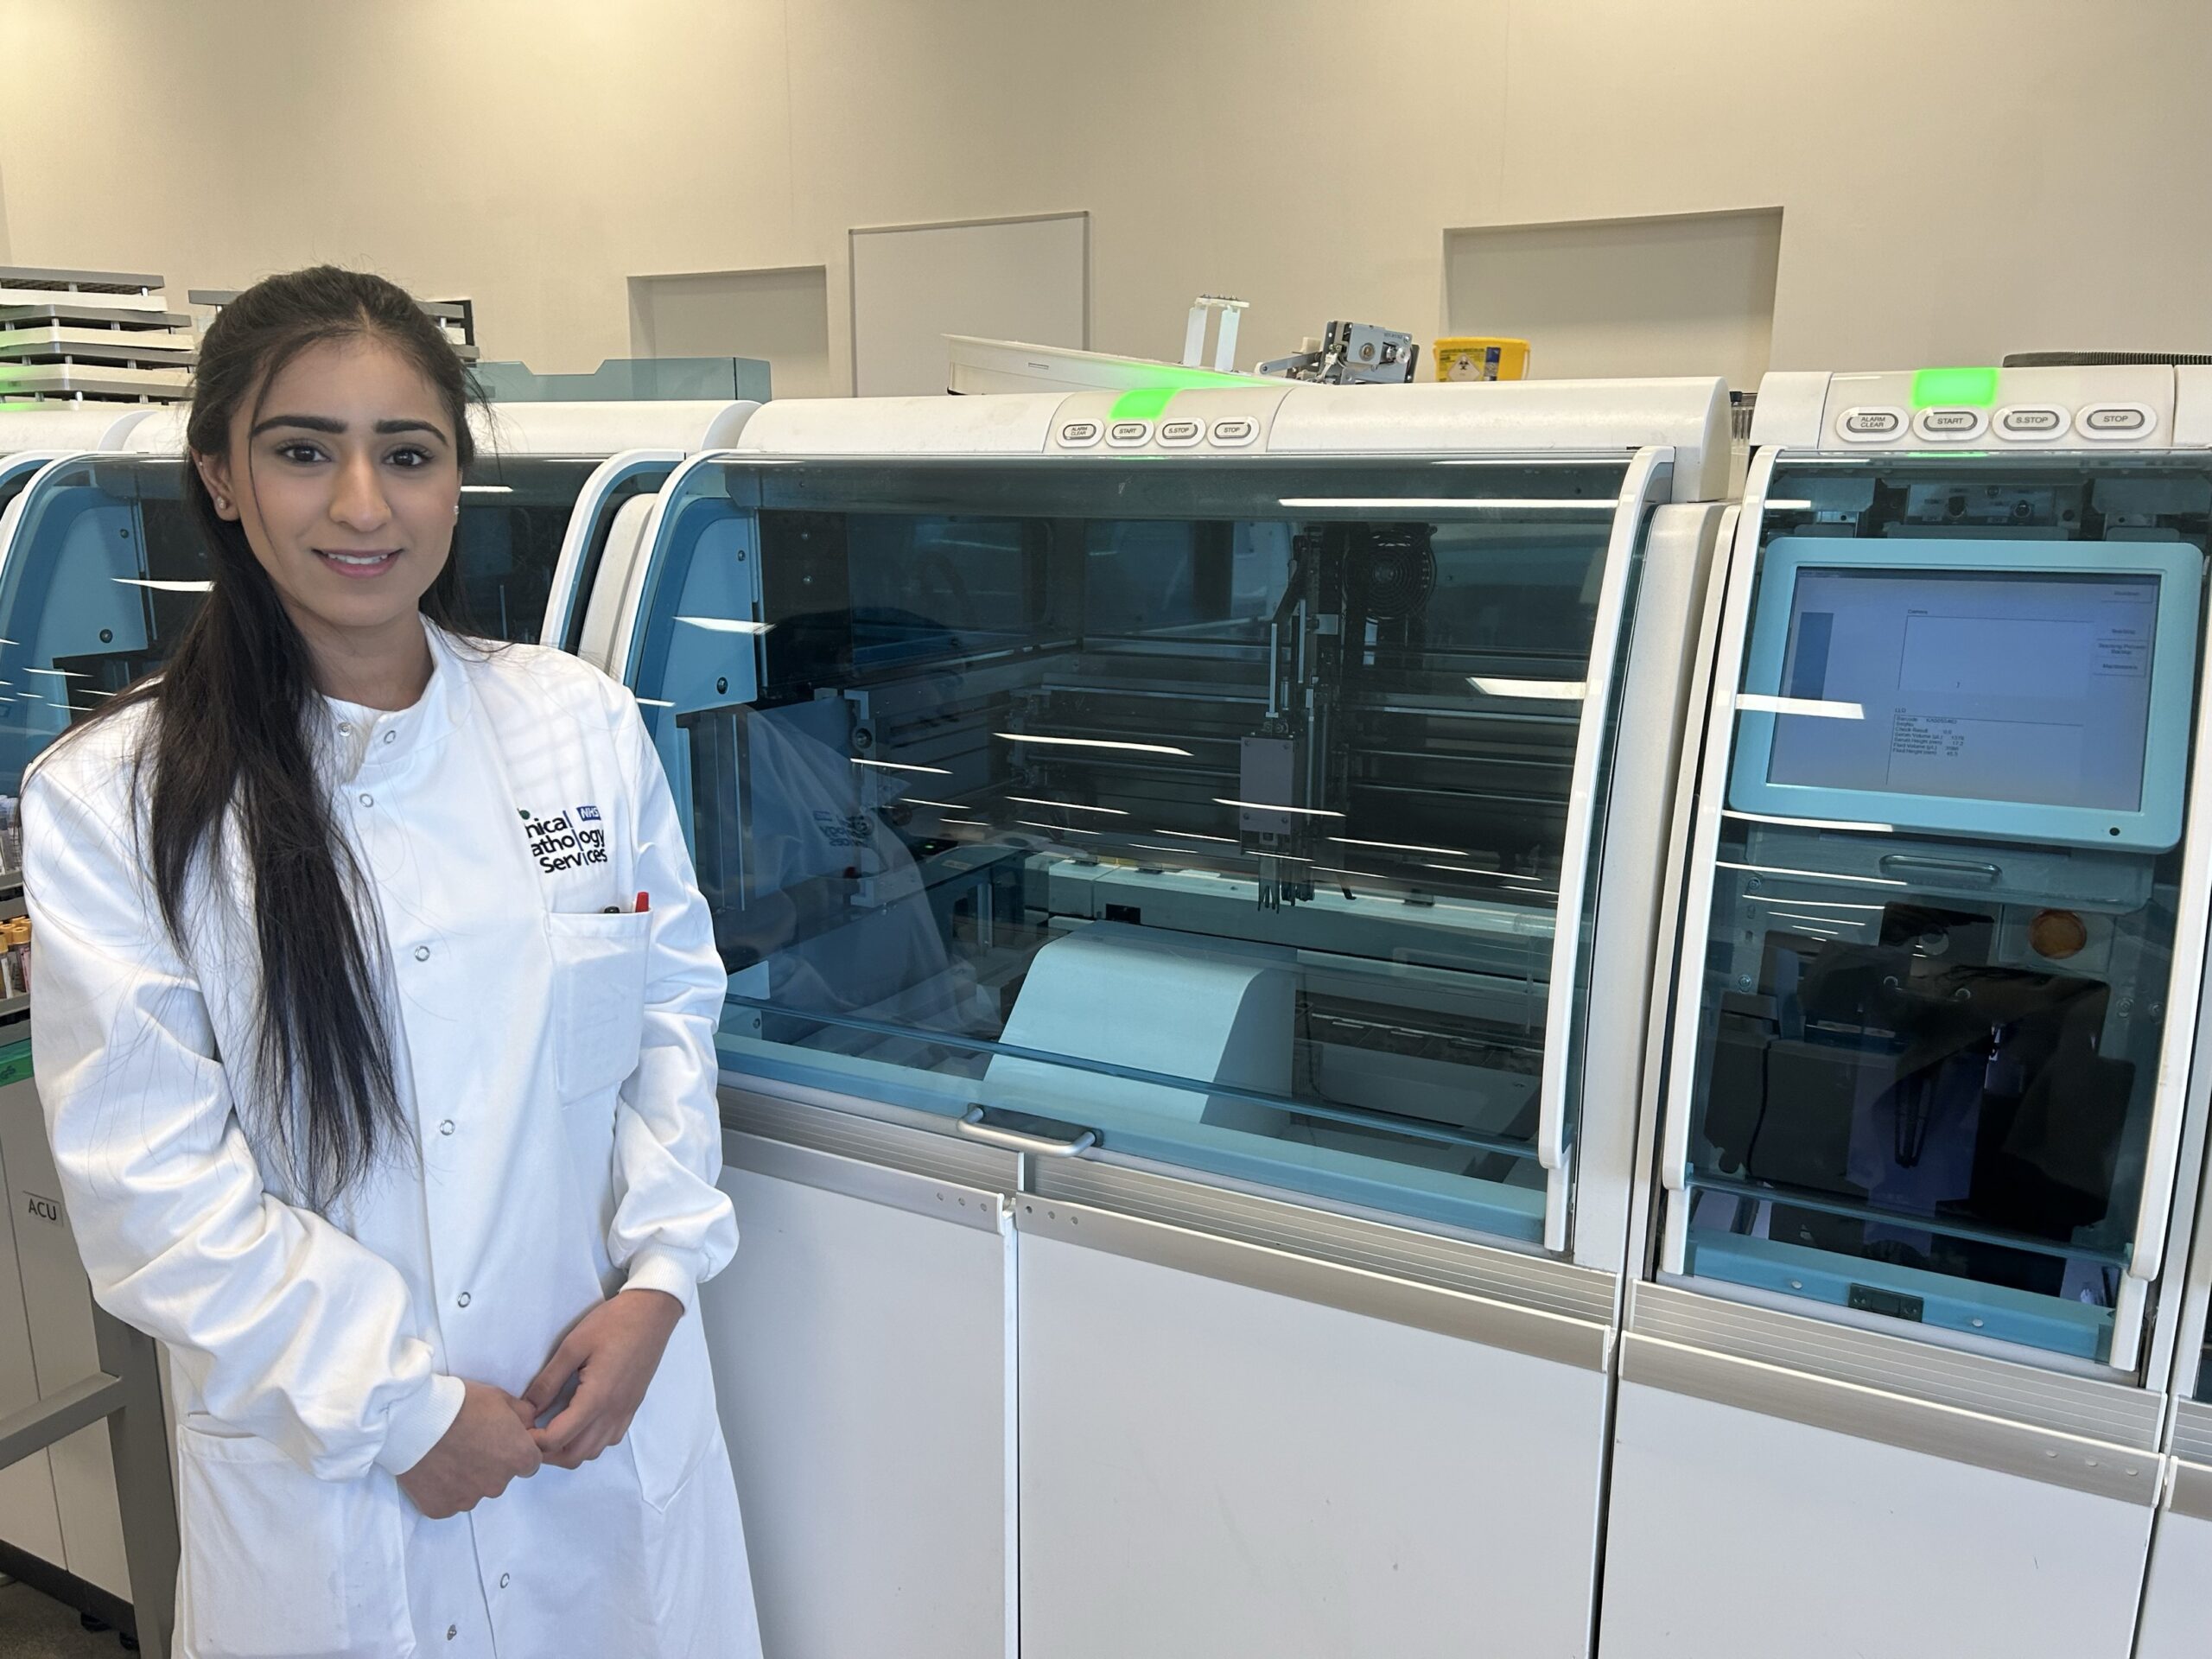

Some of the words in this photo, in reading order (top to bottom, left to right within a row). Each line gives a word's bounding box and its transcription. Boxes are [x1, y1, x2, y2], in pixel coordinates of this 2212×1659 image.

[580, 806, 600, 819] NHS
[539, 848, 607, 874] Services
[29, 1198, 57, 1221] ACU
